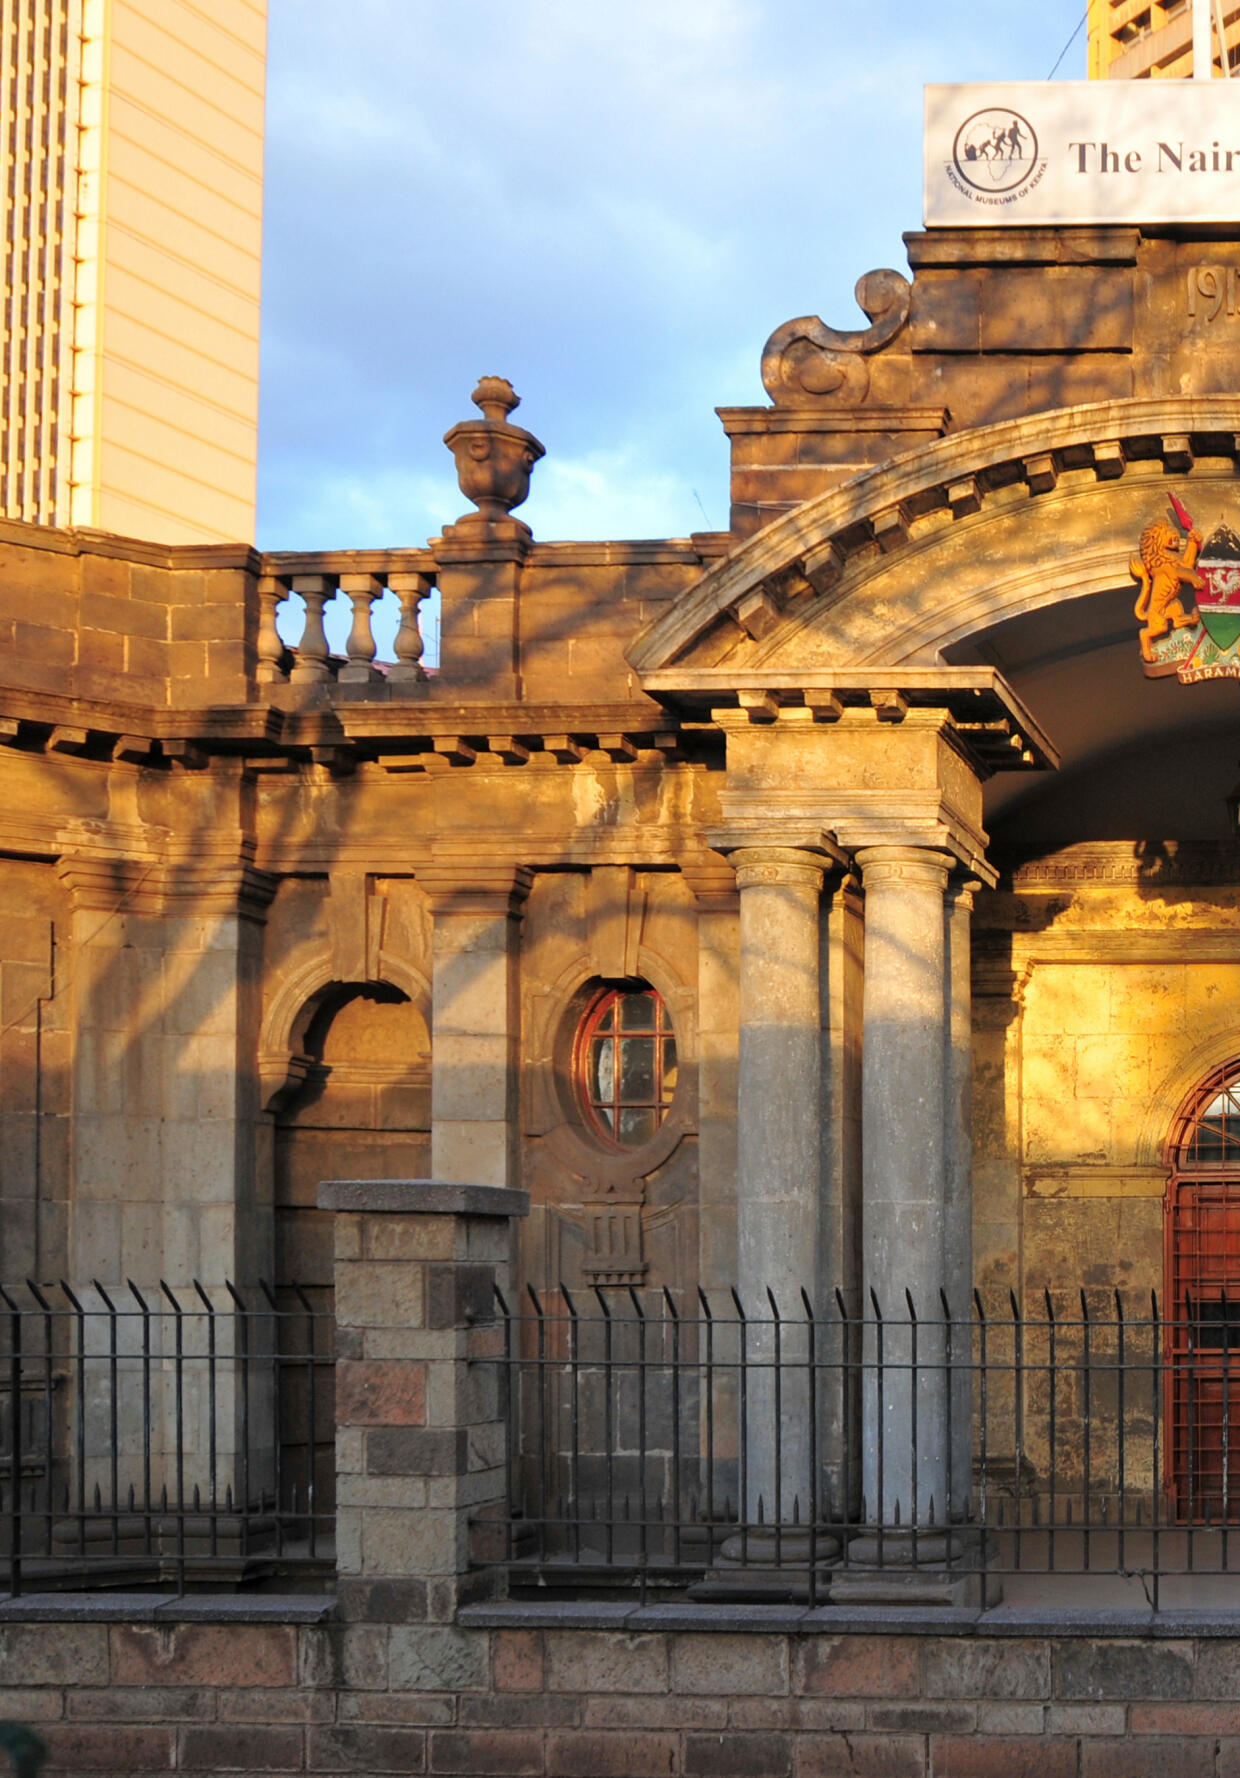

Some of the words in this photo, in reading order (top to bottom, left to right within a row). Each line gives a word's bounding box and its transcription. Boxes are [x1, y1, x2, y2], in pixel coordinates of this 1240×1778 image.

[1068, 142, 1142, 173] The
[945, 165, 974, 201] NATIONAL
[975, 194, 1018, 206] MUSEUMS
[1018, 187, 1030, 199] OF
[1029, 162, 1048, 189] KENYA
